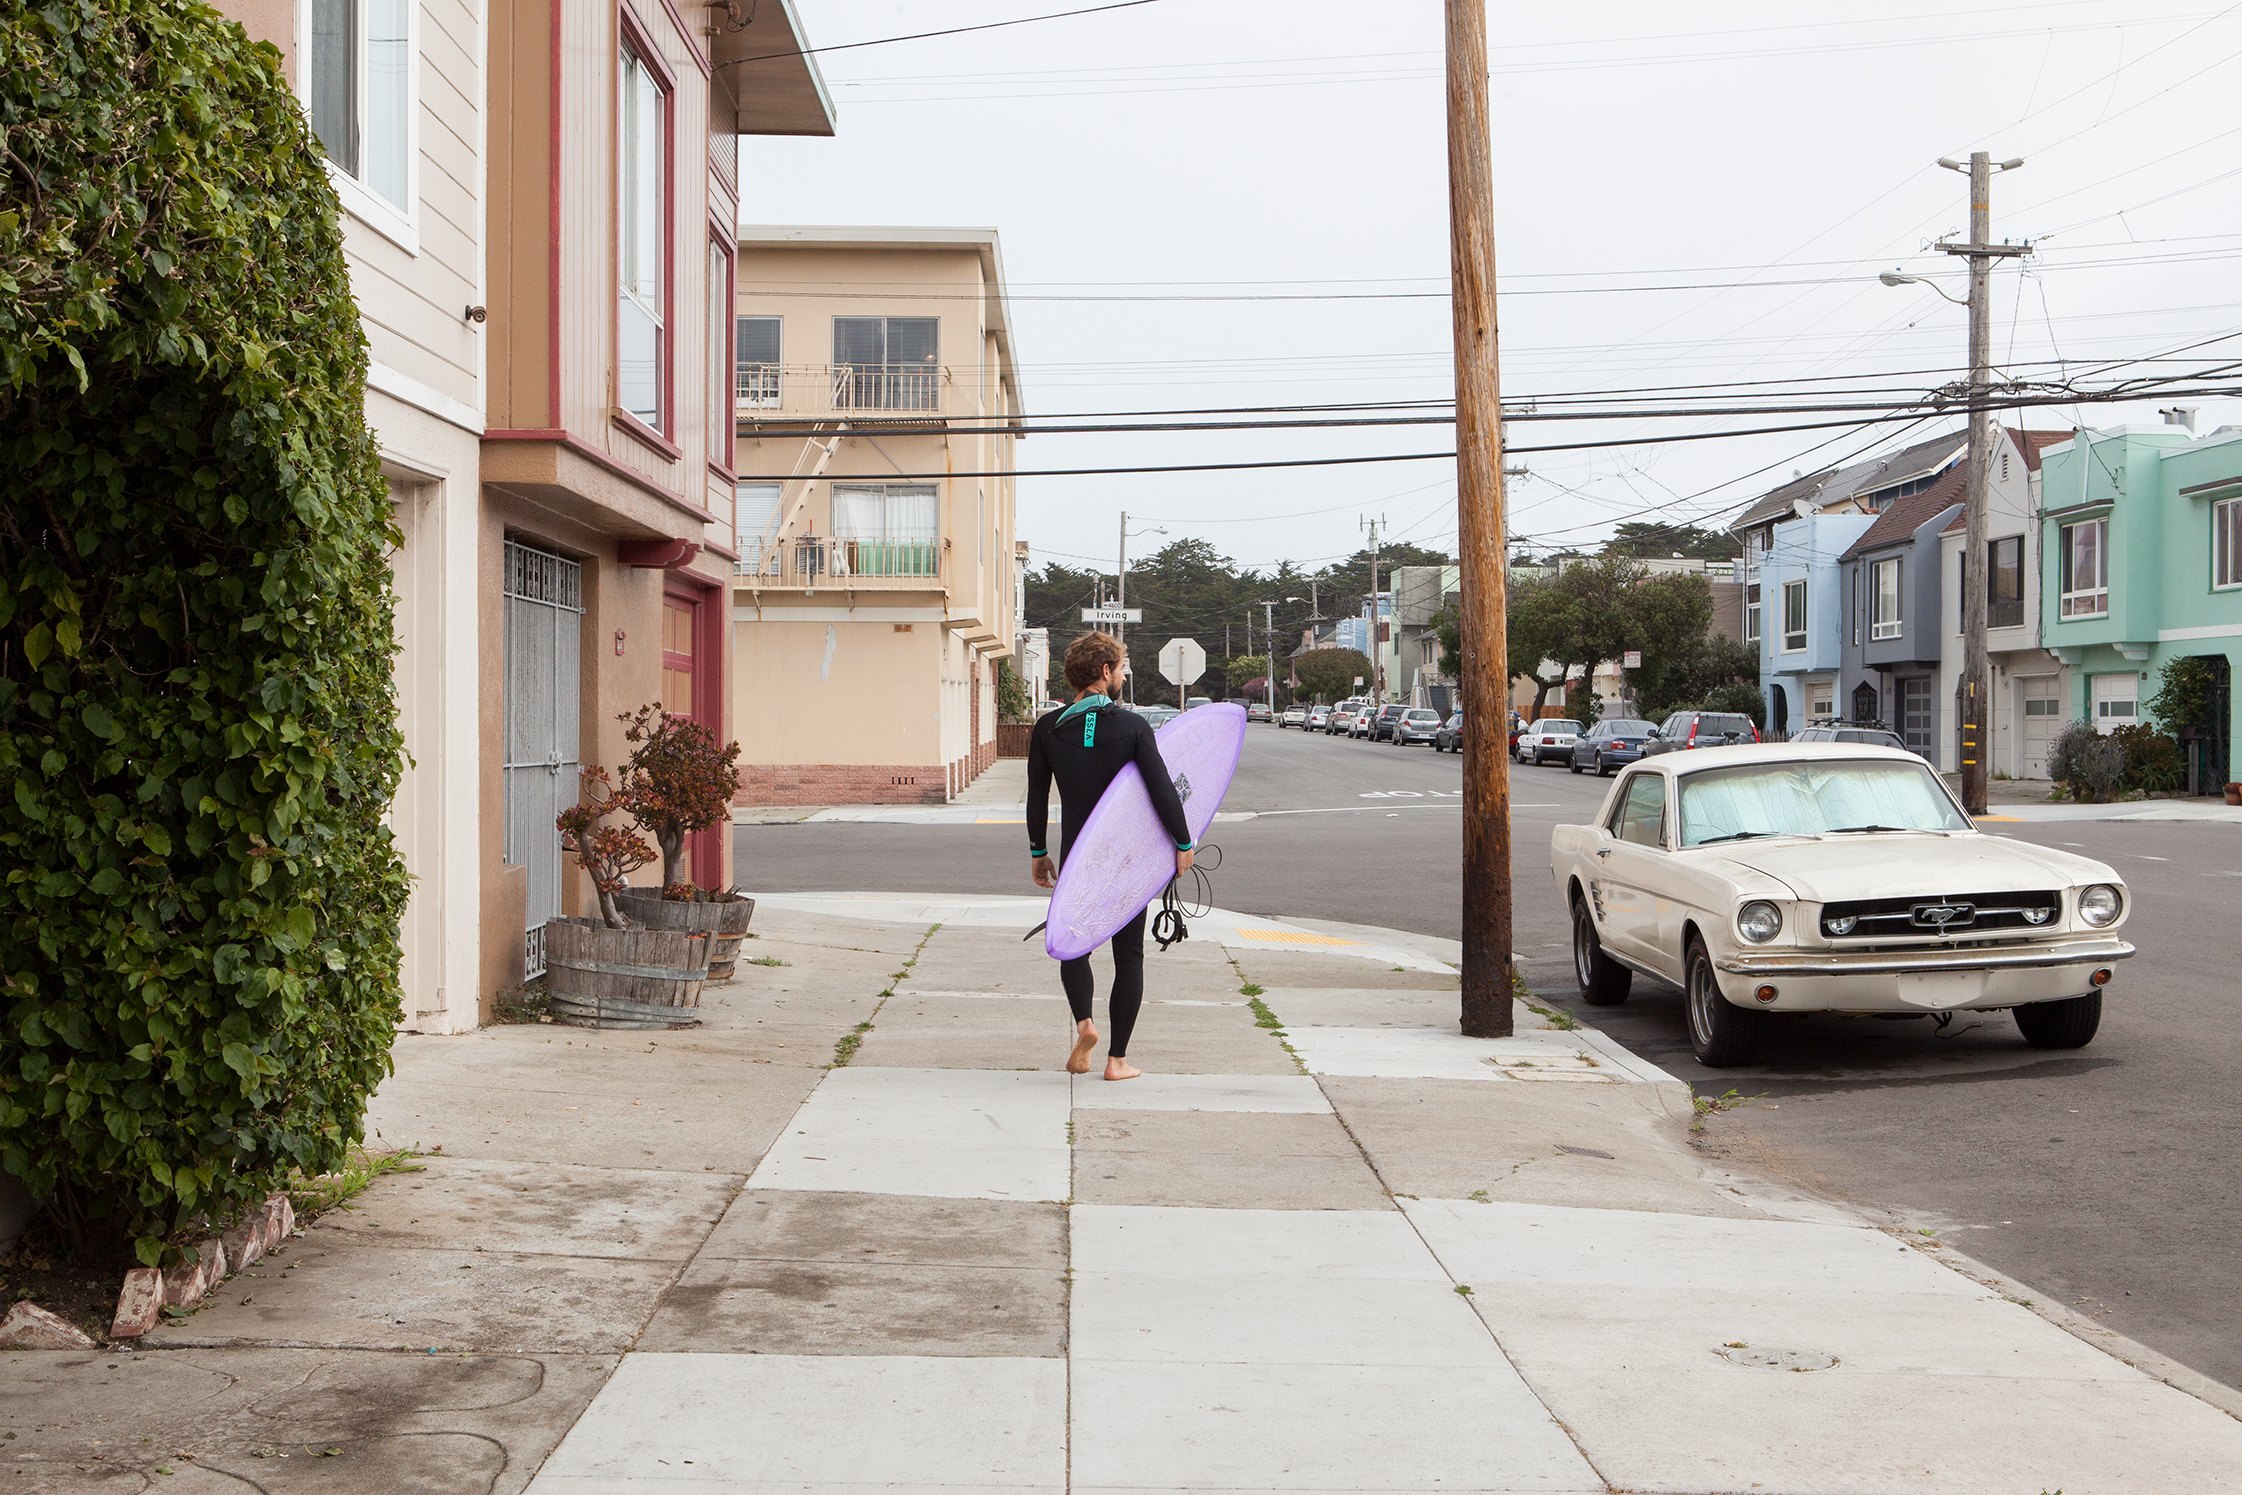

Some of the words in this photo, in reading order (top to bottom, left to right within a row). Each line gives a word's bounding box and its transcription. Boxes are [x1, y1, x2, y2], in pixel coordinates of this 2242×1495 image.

[1096, 611, 1127, 621] Irving
[1086, 712, 1094, 740] ISSLA
[1358, 790, 1463, 798] TOP
